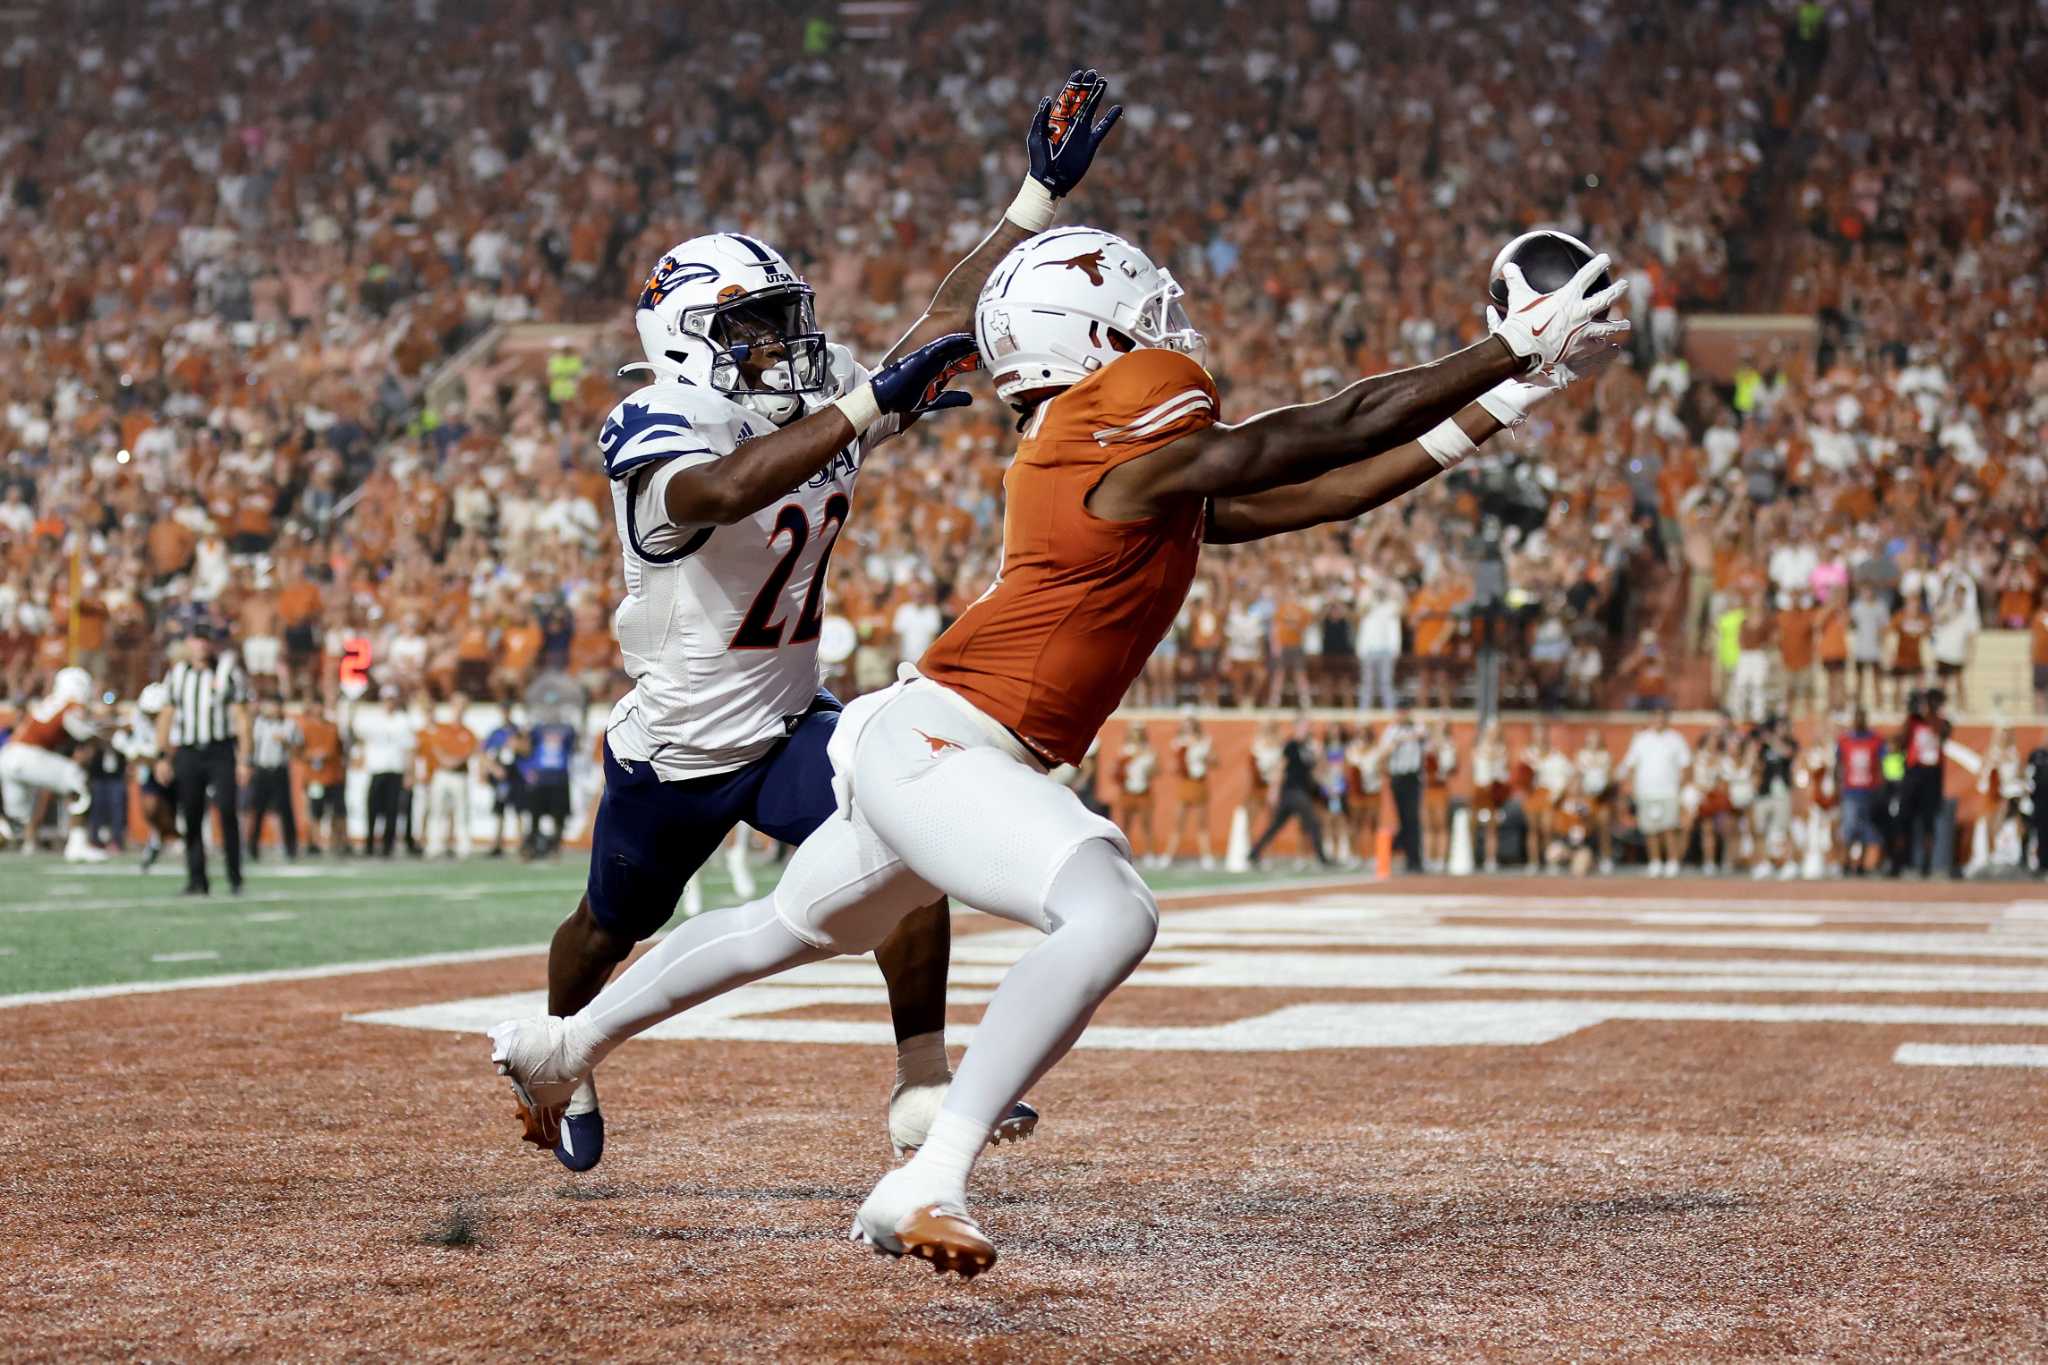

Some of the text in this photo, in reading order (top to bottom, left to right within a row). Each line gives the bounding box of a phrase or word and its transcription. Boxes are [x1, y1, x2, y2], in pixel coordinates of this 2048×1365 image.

[765, 273, 794, 284] UTSA
[727, 491, 851, 651] 22
[338, 636, 373, 686] 2
